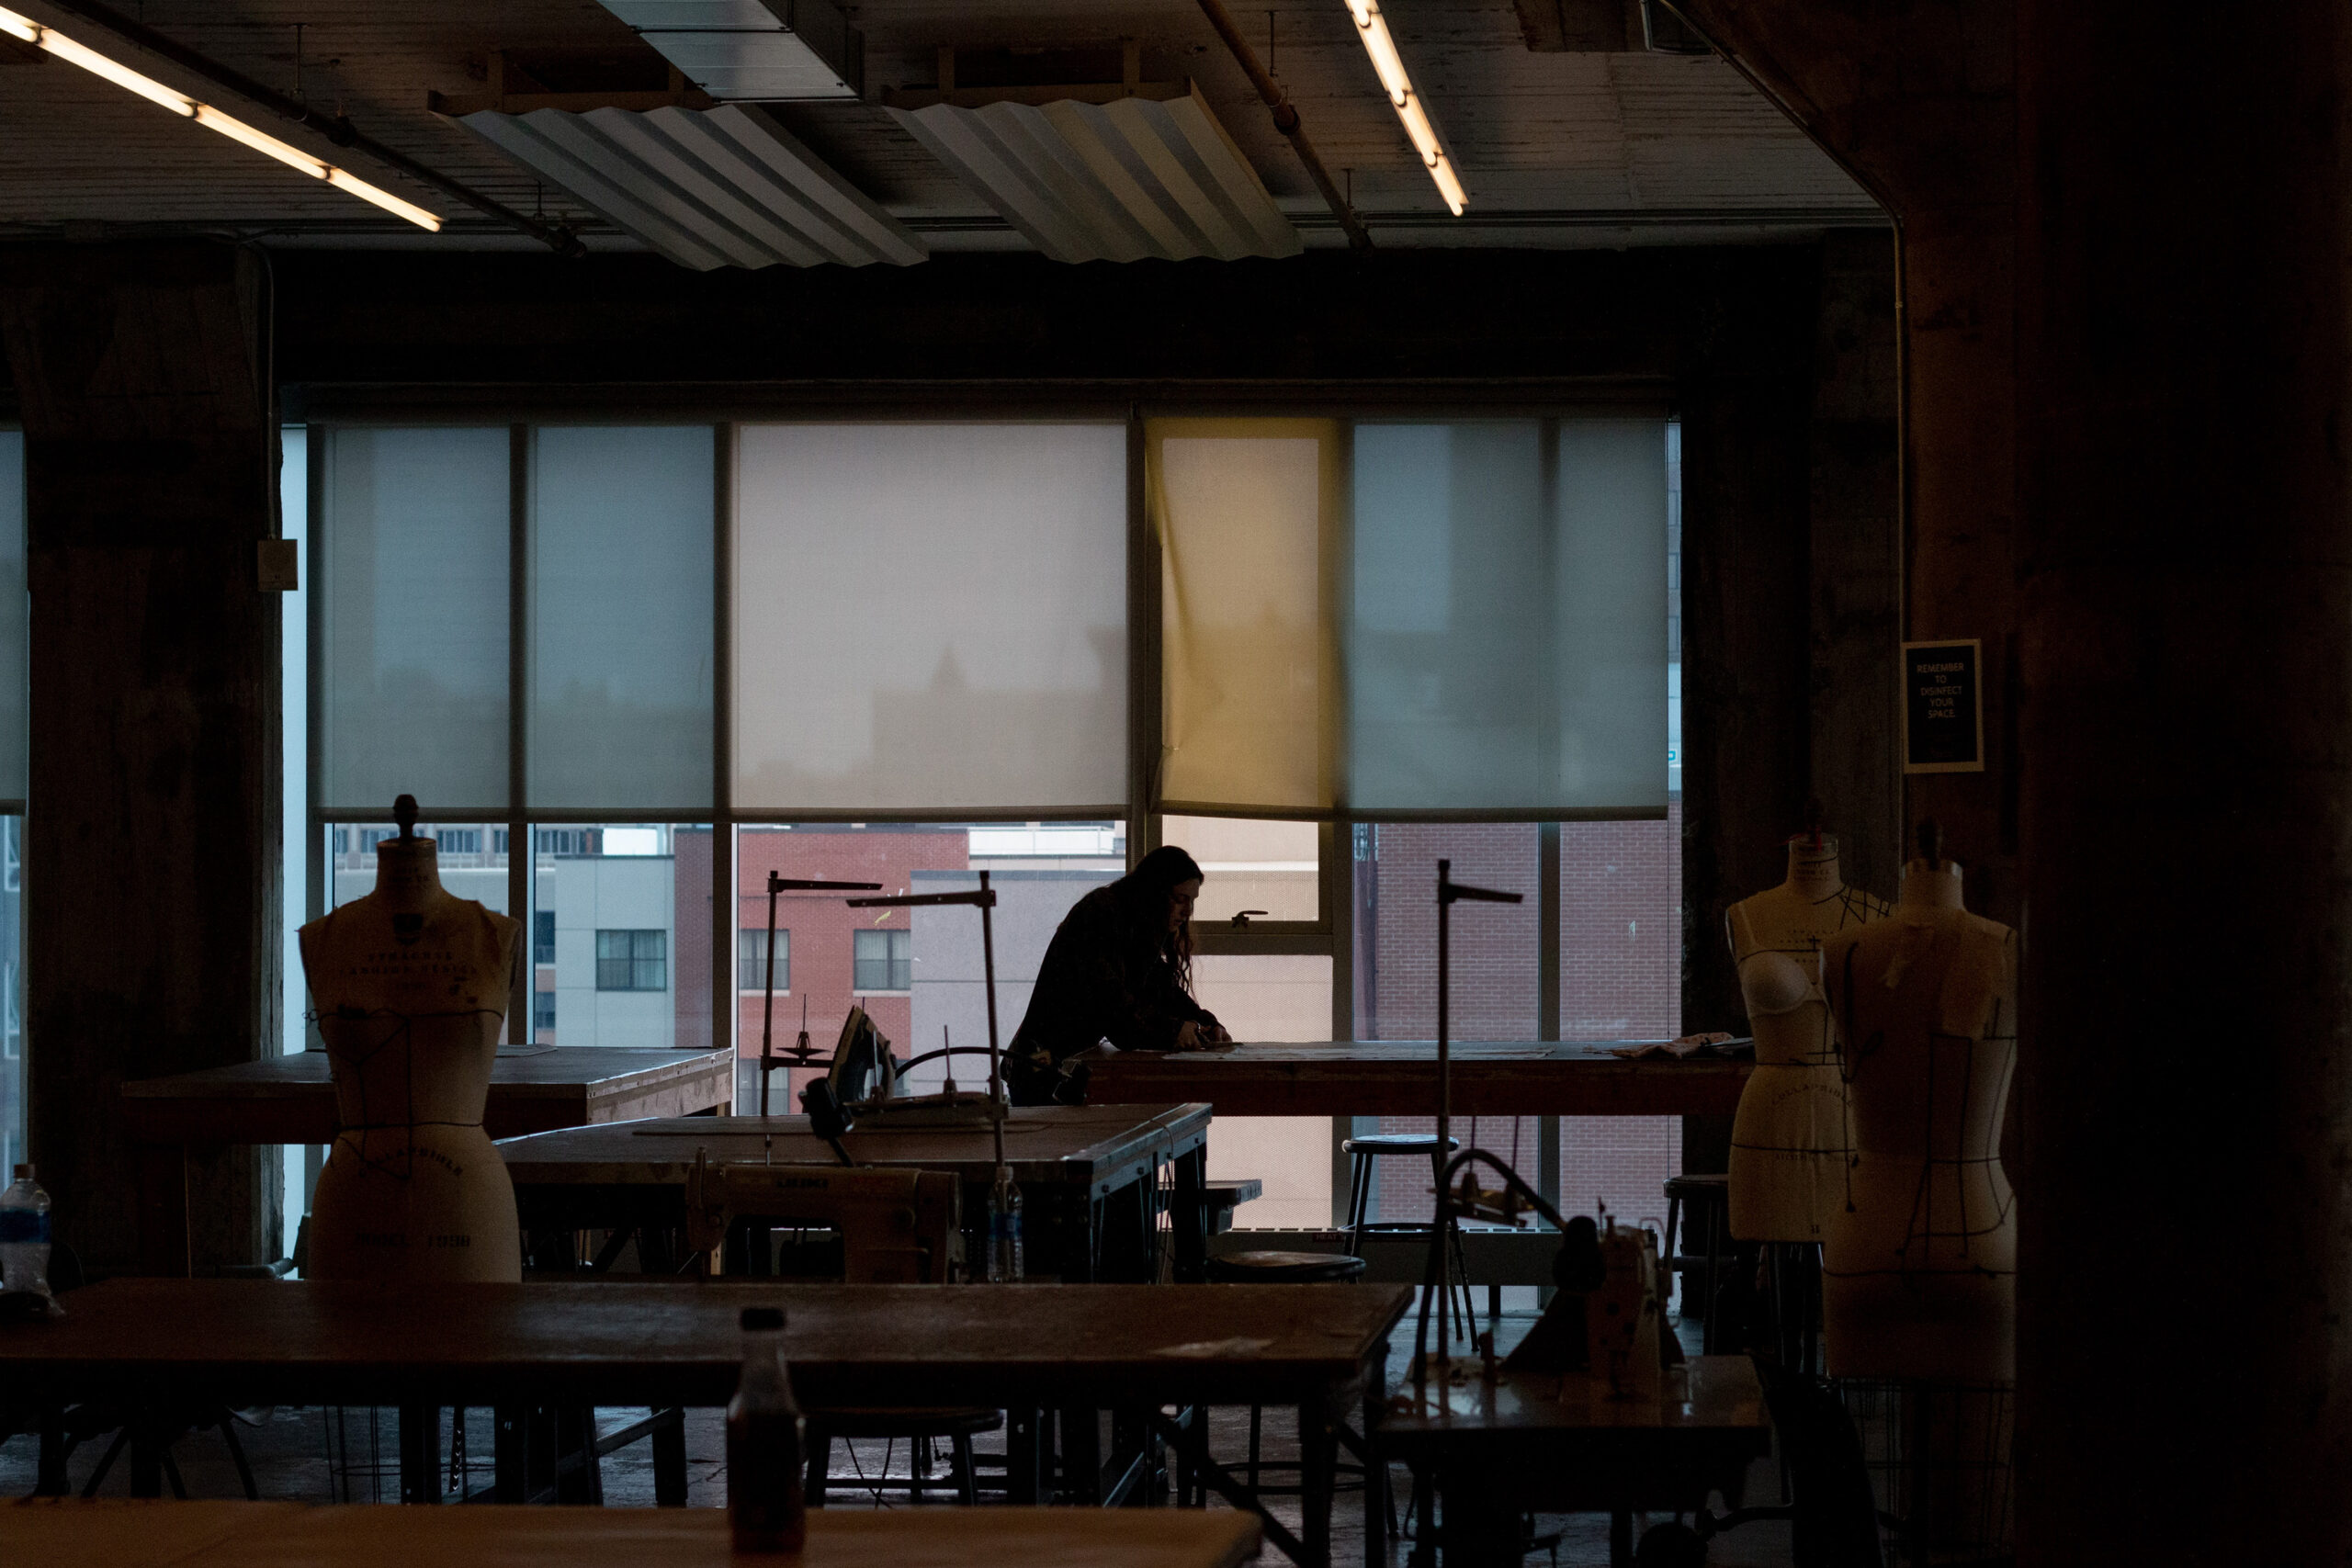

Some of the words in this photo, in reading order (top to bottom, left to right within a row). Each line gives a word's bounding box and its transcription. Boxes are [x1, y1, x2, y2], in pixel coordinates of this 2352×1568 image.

[1917, 662, 1964, 673] REMEMBER
[1934, 674, 1947, 683] TO
[1920, 685, 1962, 696] DISINFECT
[1929, 697, 1955, 707] YOUR
[1928, 709, 1955, 719] SPACE
